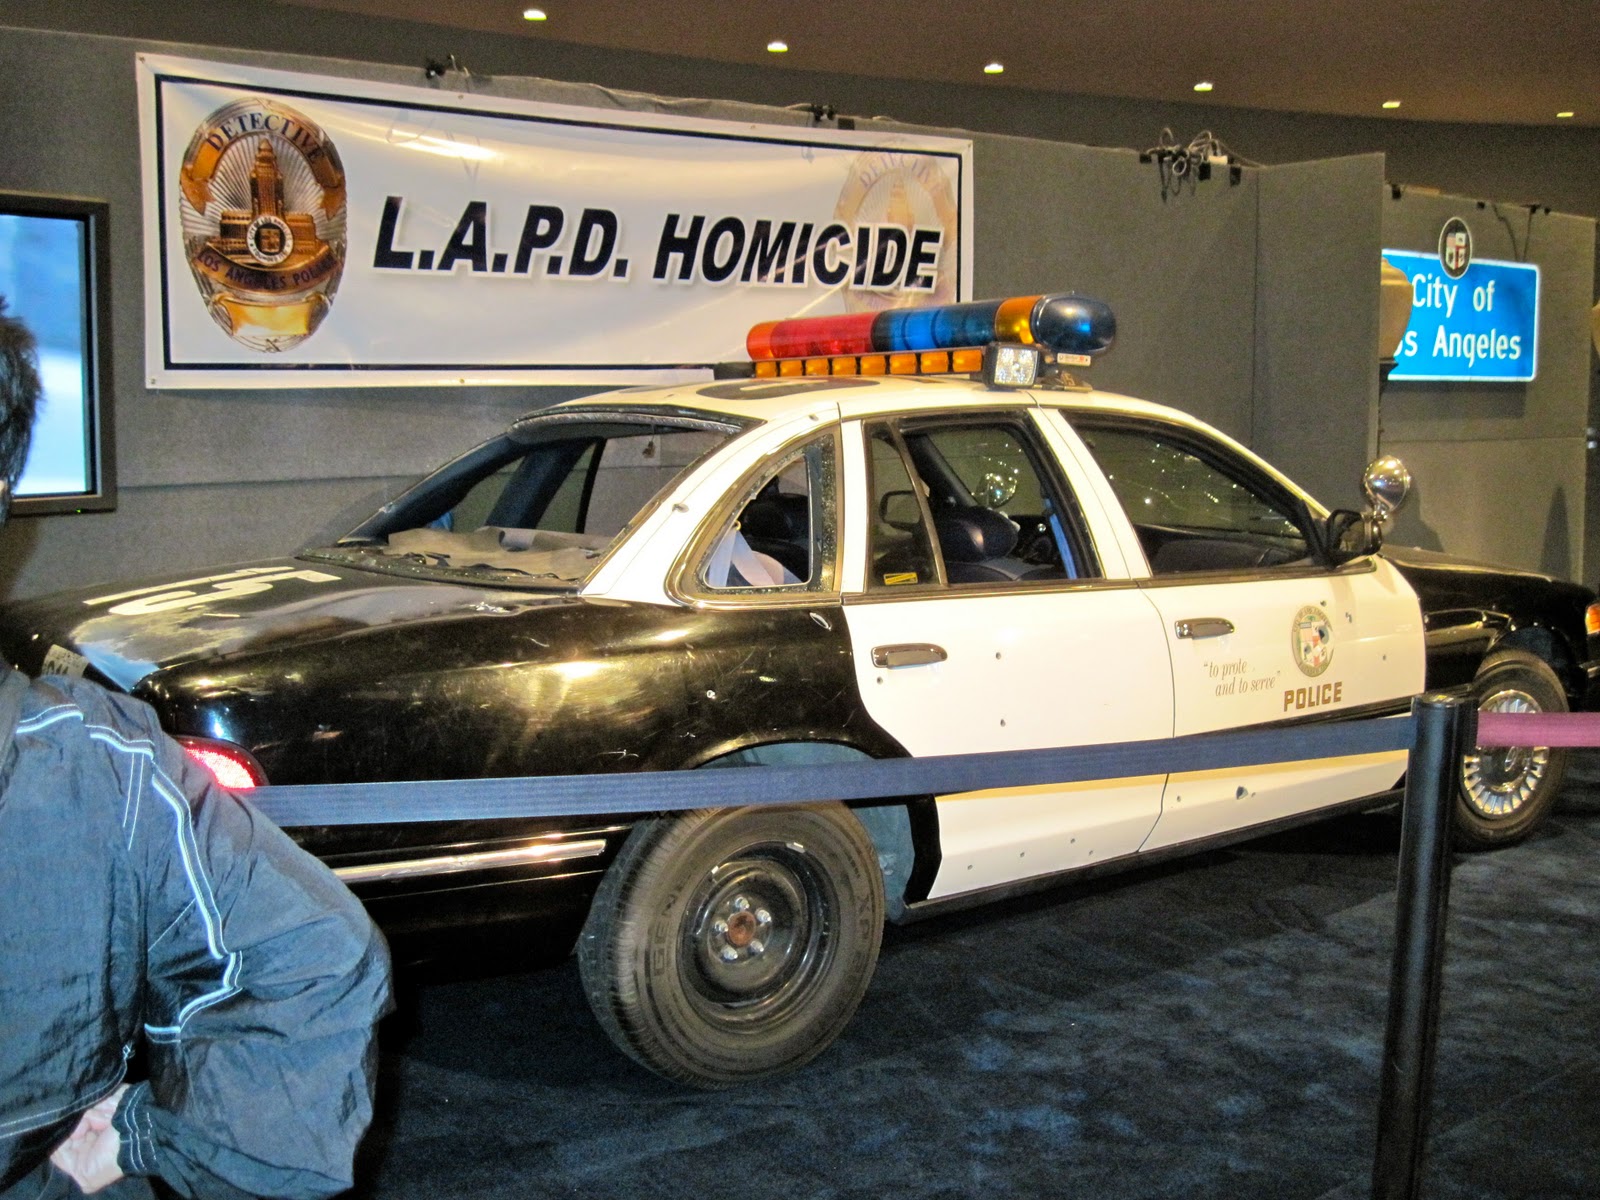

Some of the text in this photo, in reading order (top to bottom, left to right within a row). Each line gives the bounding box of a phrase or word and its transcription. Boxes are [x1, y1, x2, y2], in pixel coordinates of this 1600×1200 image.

[207, 112, 326, 159] DETECTIVE
[373, 196, 629, 278] L.A.P.D.
[653, 214, 941, 288] HOMICIDE
[225, 266, 287, 290] ANGLES
[1412, 273, 1495, 318] City of
[1432, 324, 1521, 368] Angeles
[1215, 676, 1236, 697] and
[1239, 679, 1248, 694] to
[1283, 681, 1343, 712] POLICE
